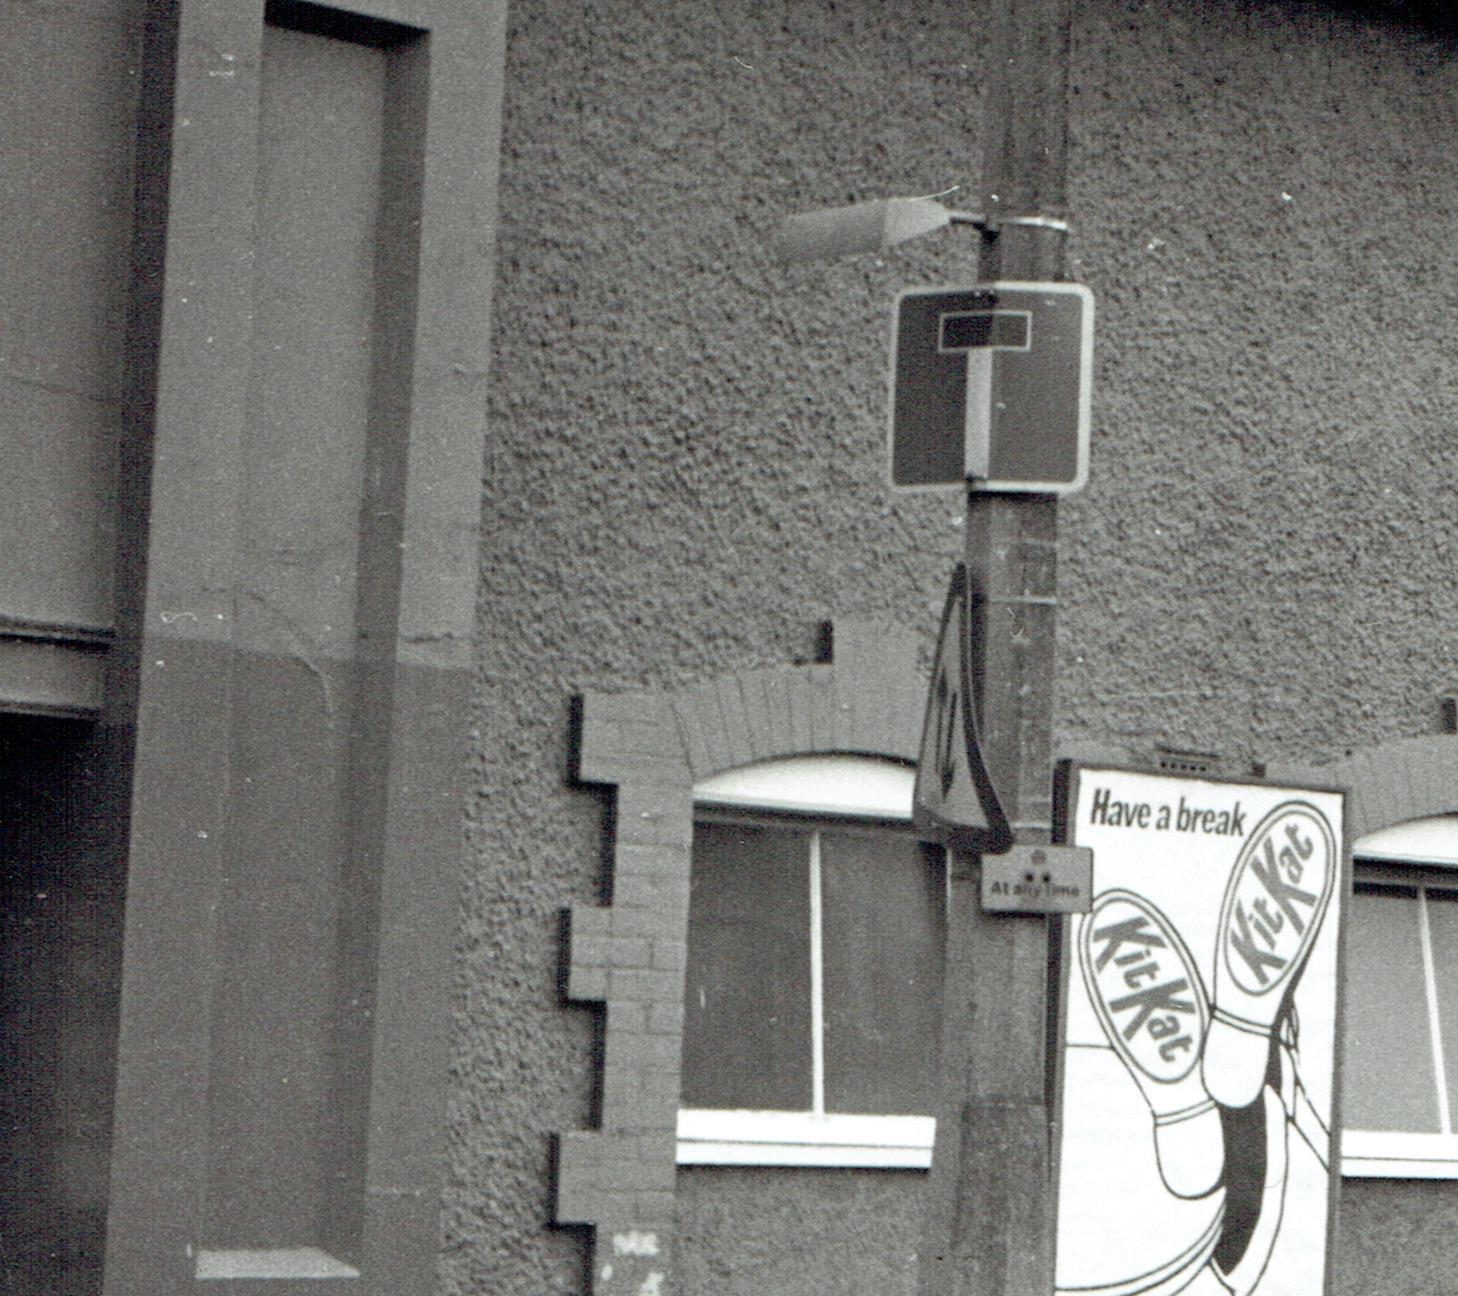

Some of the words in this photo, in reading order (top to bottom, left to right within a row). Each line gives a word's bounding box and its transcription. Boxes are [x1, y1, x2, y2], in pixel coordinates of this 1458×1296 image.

[1090, 788, 1151, 829] Have
[1156, 805, 1171, 830] a
[1176, 795, 1247, 837] break
